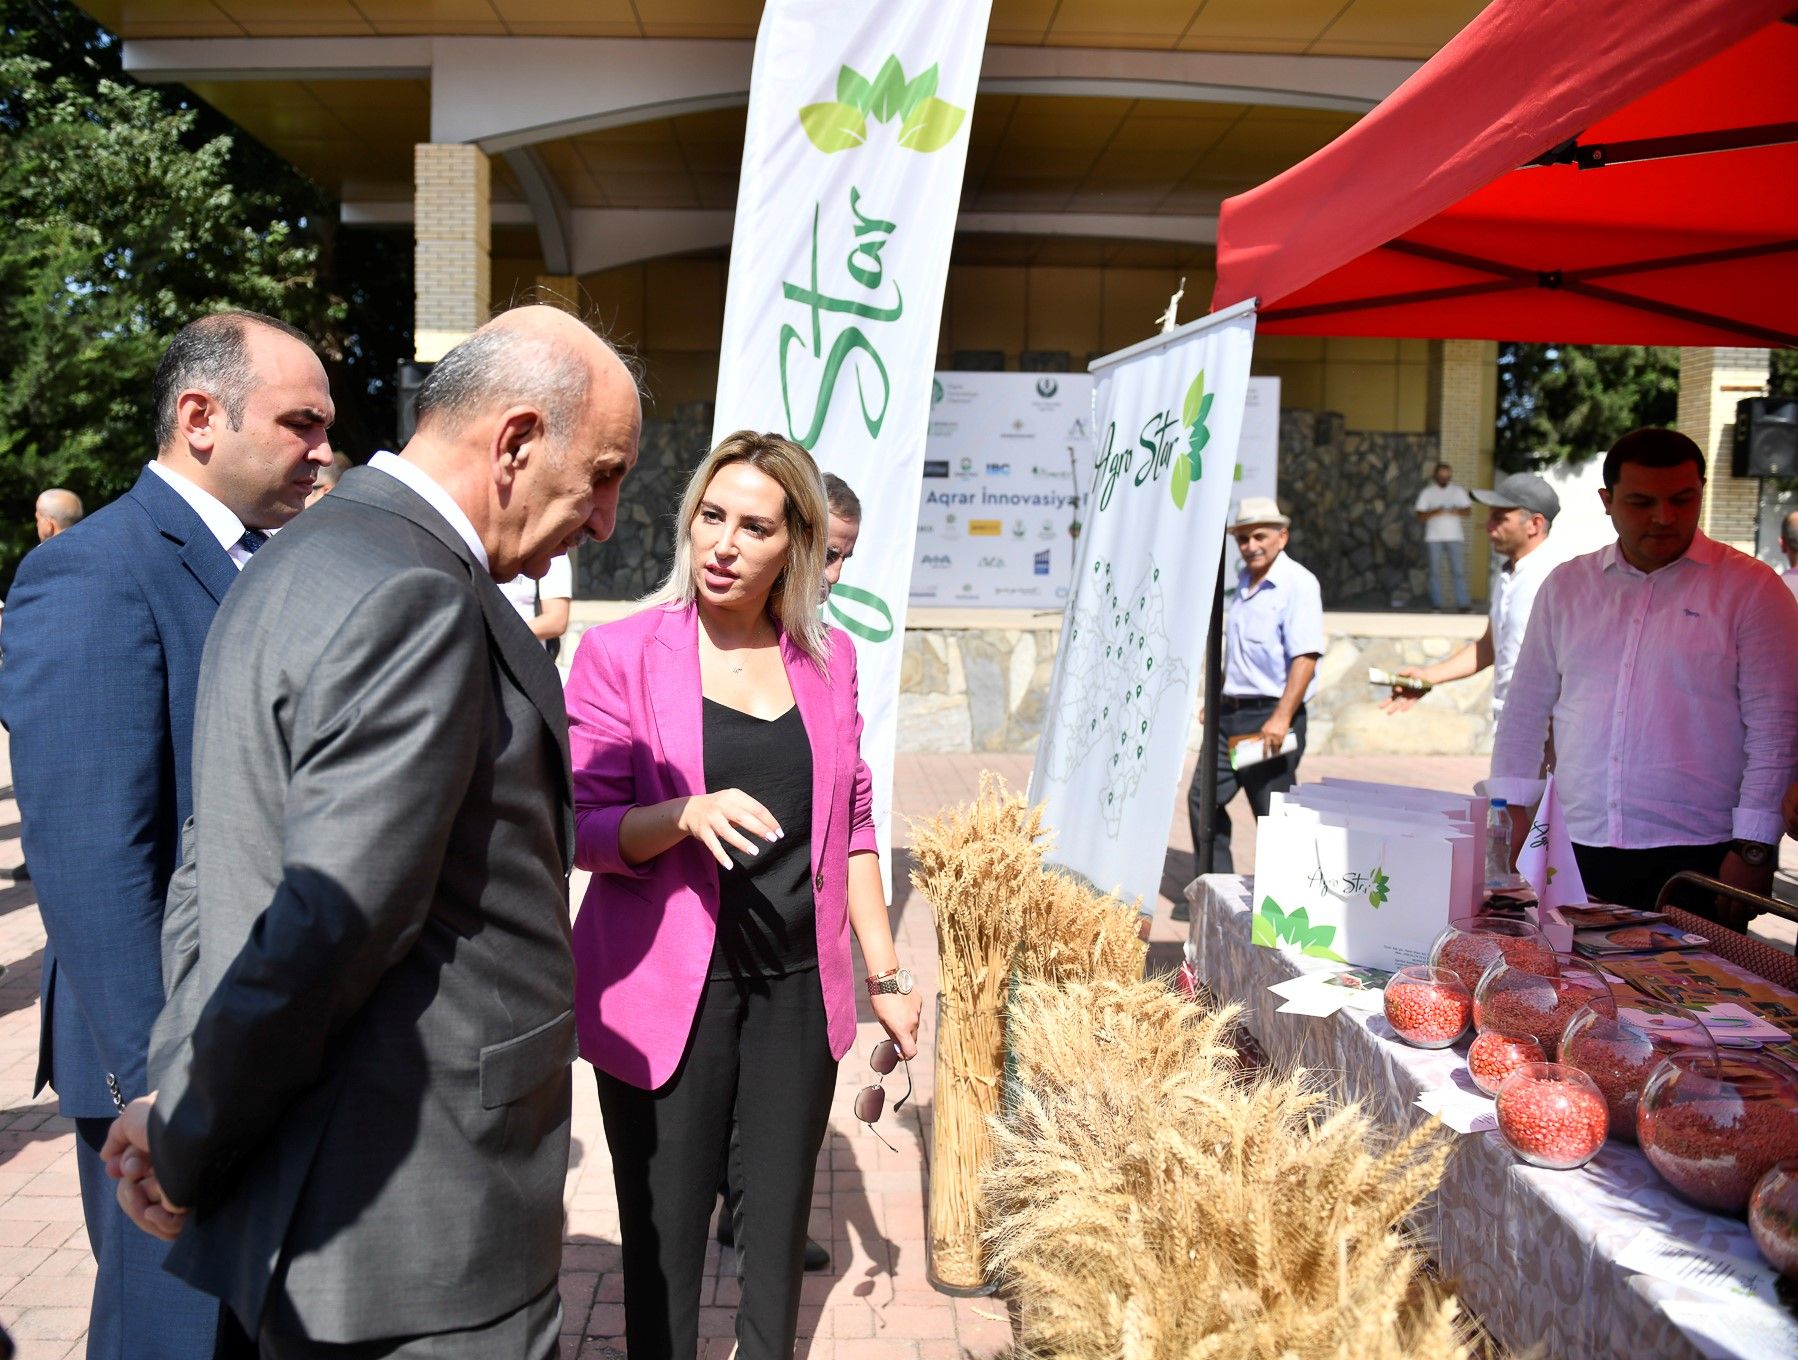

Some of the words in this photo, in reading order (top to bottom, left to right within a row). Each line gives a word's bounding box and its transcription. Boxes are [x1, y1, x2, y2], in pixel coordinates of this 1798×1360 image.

[779, 185, 903, 451] Star
[926, 490, 976, 507] Aqrar
[1091, 421, 1133, 512] Agro
[1134, 409, 1180, 487] Star
